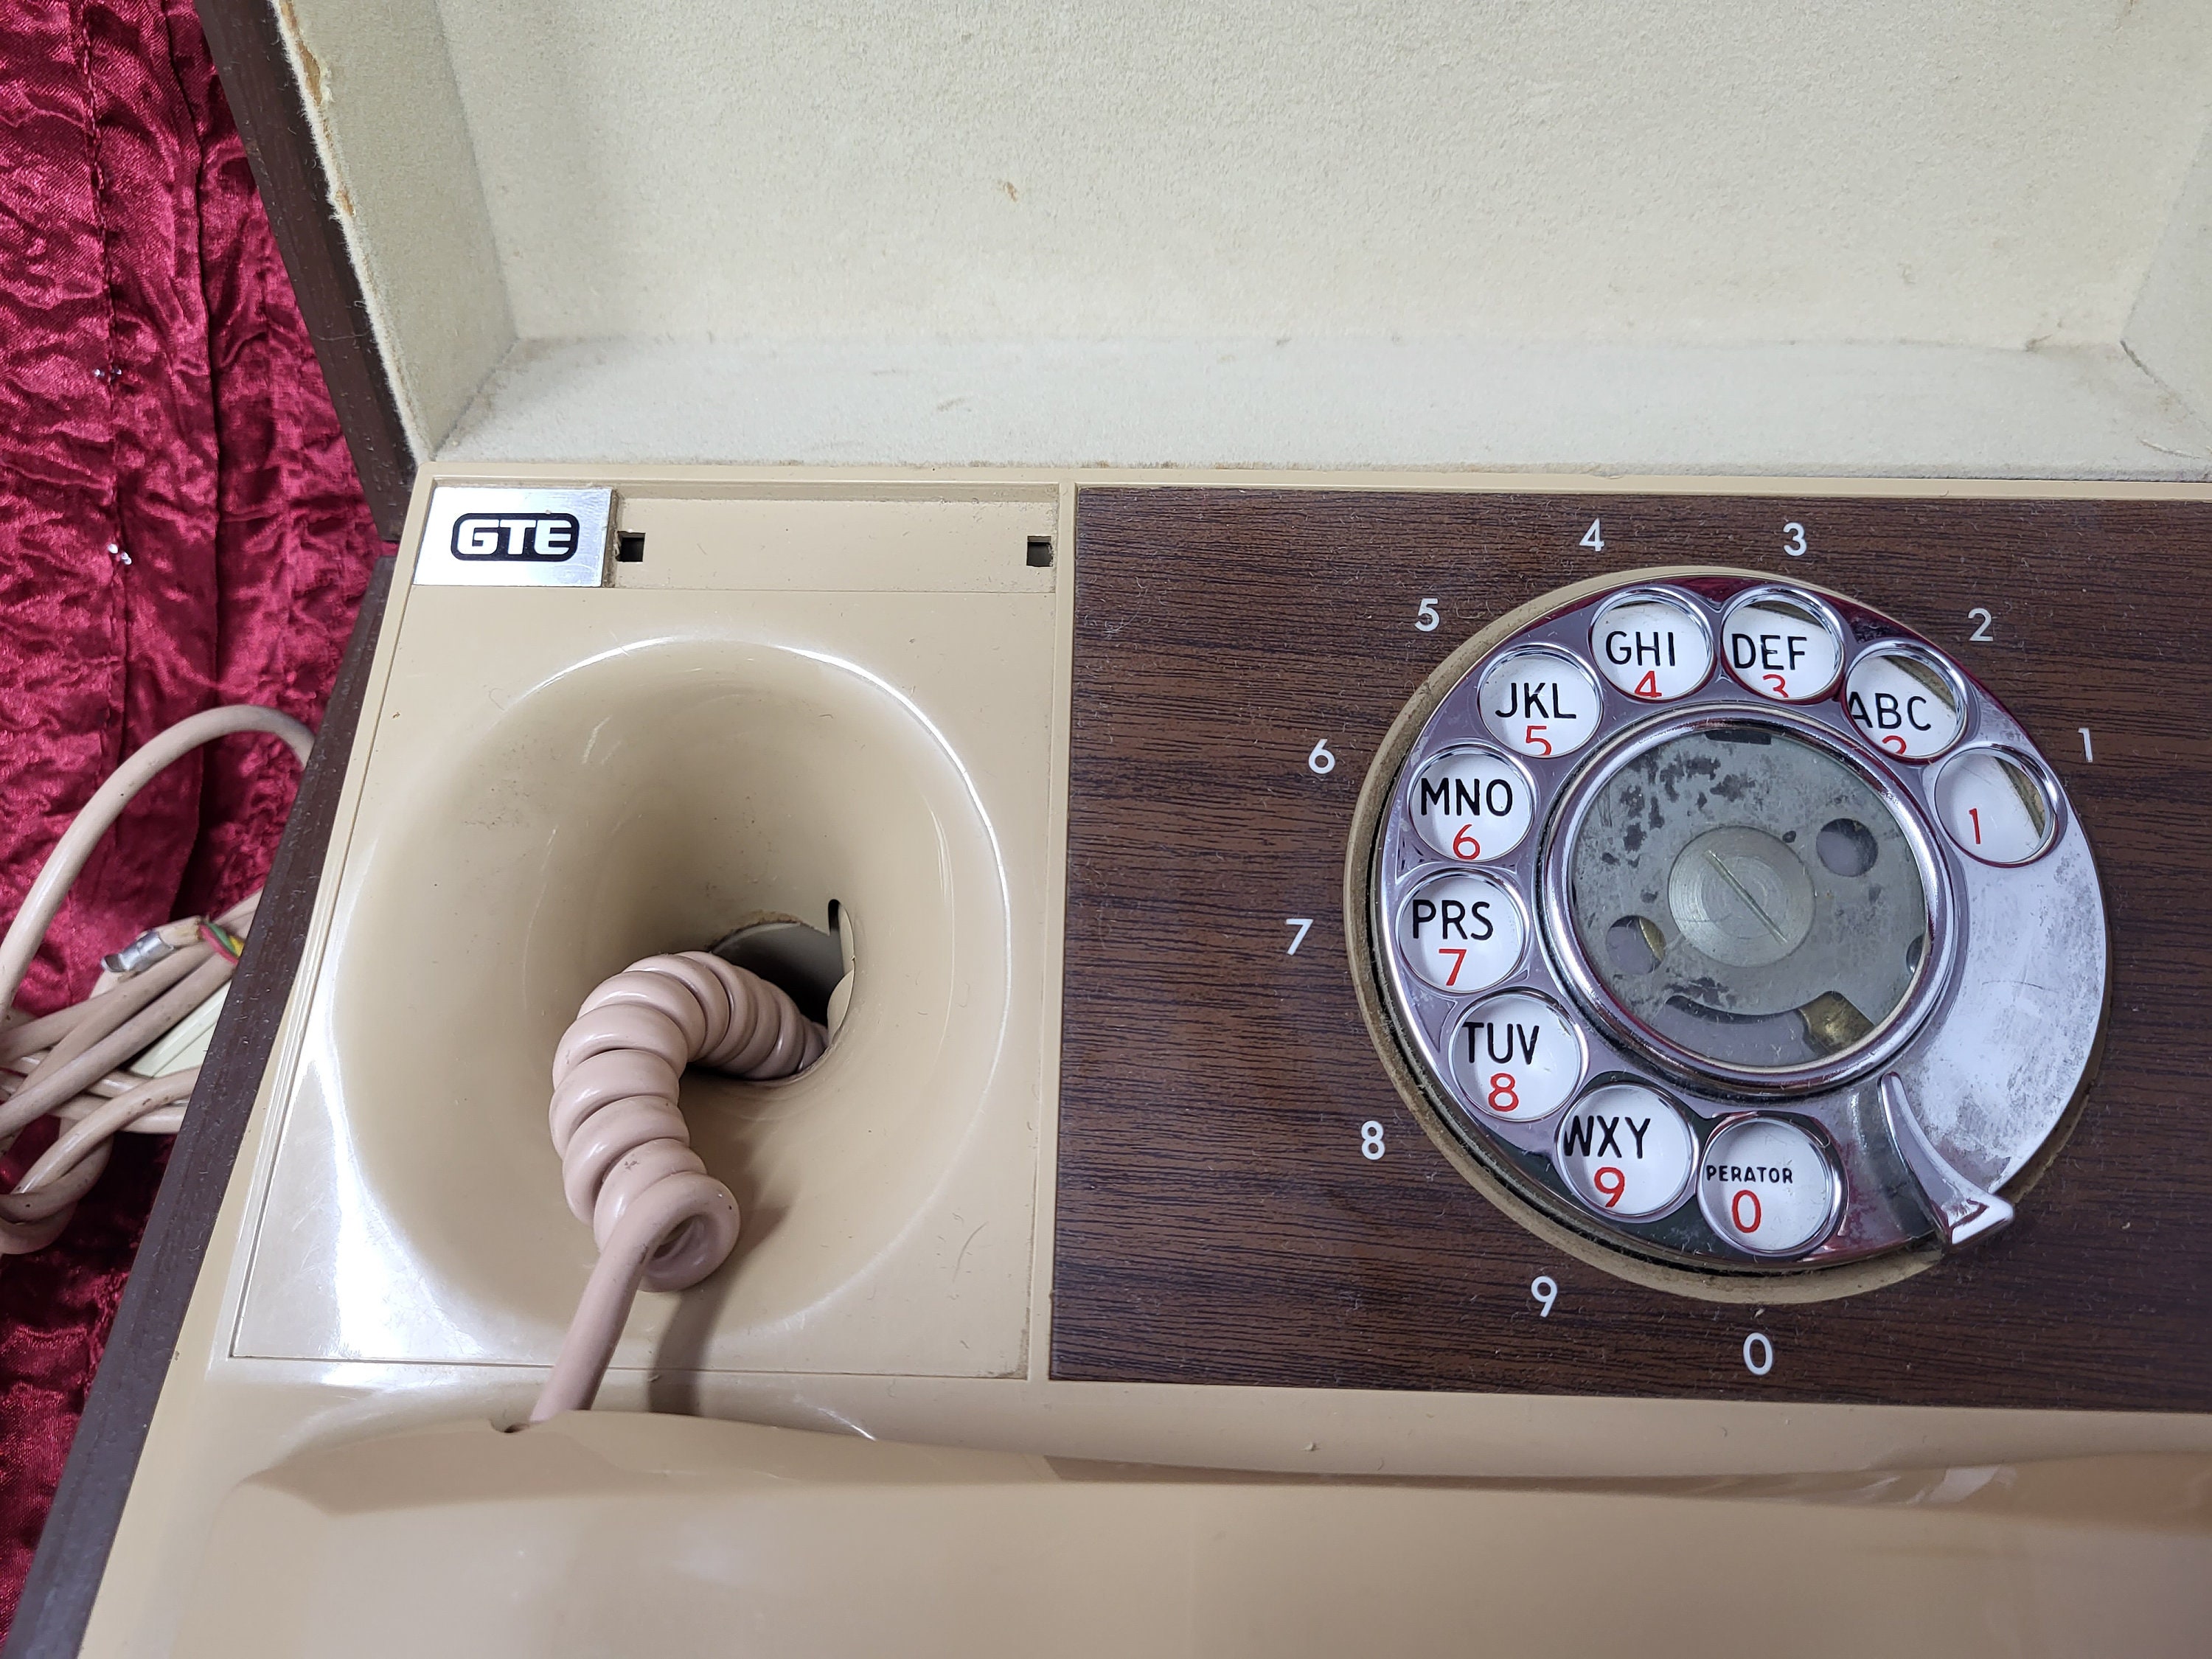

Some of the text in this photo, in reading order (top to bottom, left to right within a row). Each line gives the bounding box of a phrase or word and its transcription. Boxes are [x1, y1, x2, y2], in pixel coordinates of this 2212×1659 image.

[456, 518, 572, 555] GTE
[1579, 518, 1605, 552] 4
[1783, 522, 1807, 556] 3
[1414, 597, 1440, 632] 5
[1967, 608, 1994, 641] 2
[1605, 630, 1676, 667] GHI
[1731, 633, 1808, 671] DEF
[1495, 682, 1577, 720] JKL
[1634, 670, 1663, 698] 4
[1848, 691, 1932, 731] ABC
[1308, 738, 1336, 774] 6
[1524, 725, 1553, 756] 5
[2079, 727, 2093, 763] 1
[1420, 777, 1514, 817] MNO
[1453, 824, 1481, 860] 6
[1969, 807, 1981, 845] 1
[1285, 918, 1314, 956] 7
[1412, 899, 1494, 942] PRS
[1438, 947, 1467, 987] 7
[1461, 1021, 1540, 1065] TUV
[1487, 1072, 1520, 1112] 8
[1360, 1120, 1386, 1161] 8
[1563, 1114, 1652, 1159] WXY
[1593, 1166, 1626, 1208] 9
[1705, 1164, 1793, 1184] PERATOR
[1731, 1189, 1762, 1234] 0
[1531, 1276, 1558, 1318] 9
[1742, 1332, 1774, 1376] 0
